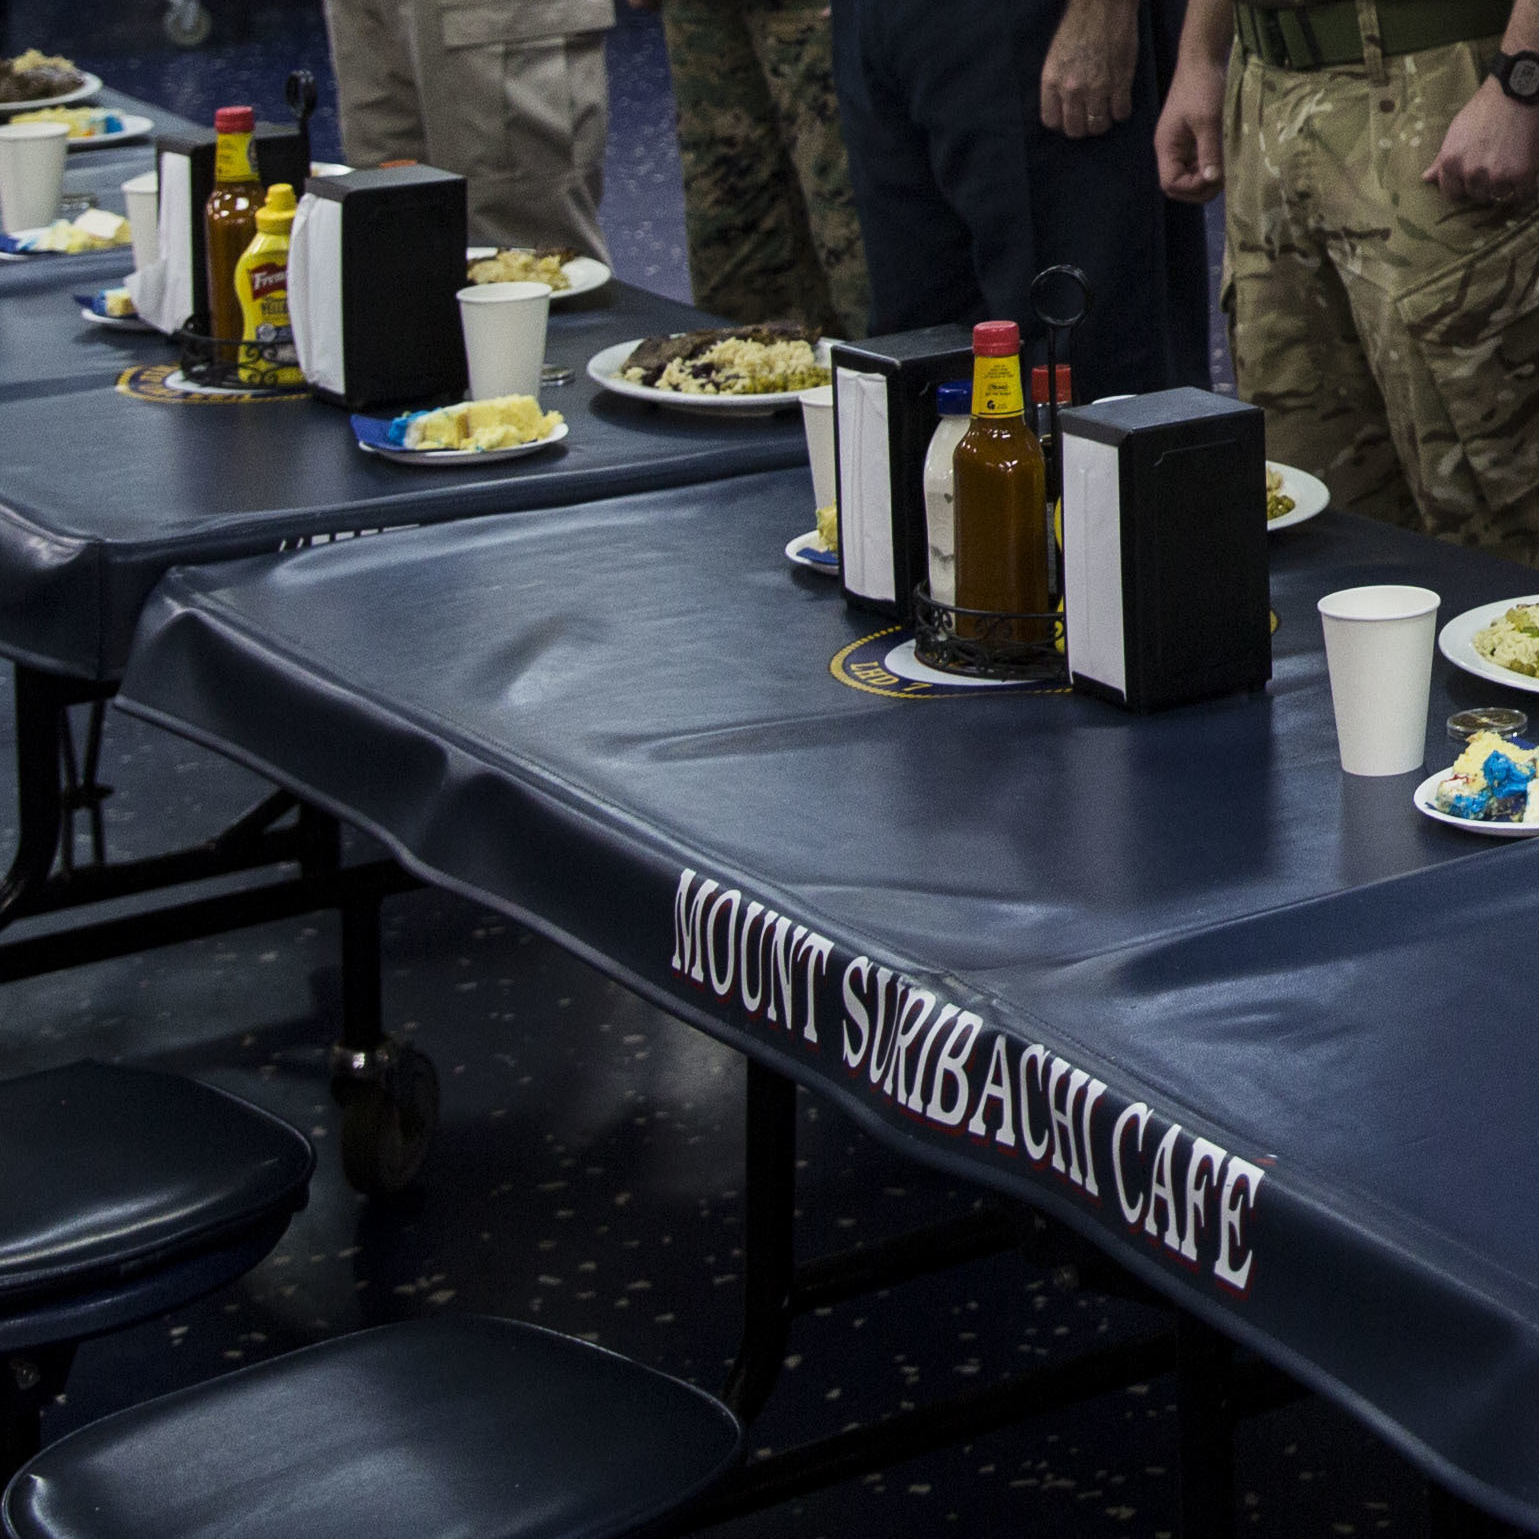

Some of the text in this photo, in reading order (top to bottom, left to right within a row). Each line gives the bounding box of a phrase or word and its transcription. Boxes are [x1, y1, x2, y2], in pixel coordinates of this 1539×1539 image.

[850, 660, 901, 687] LHD
[671, 866, 1266, 1291] MOUNT SURIBACHI CAFE
